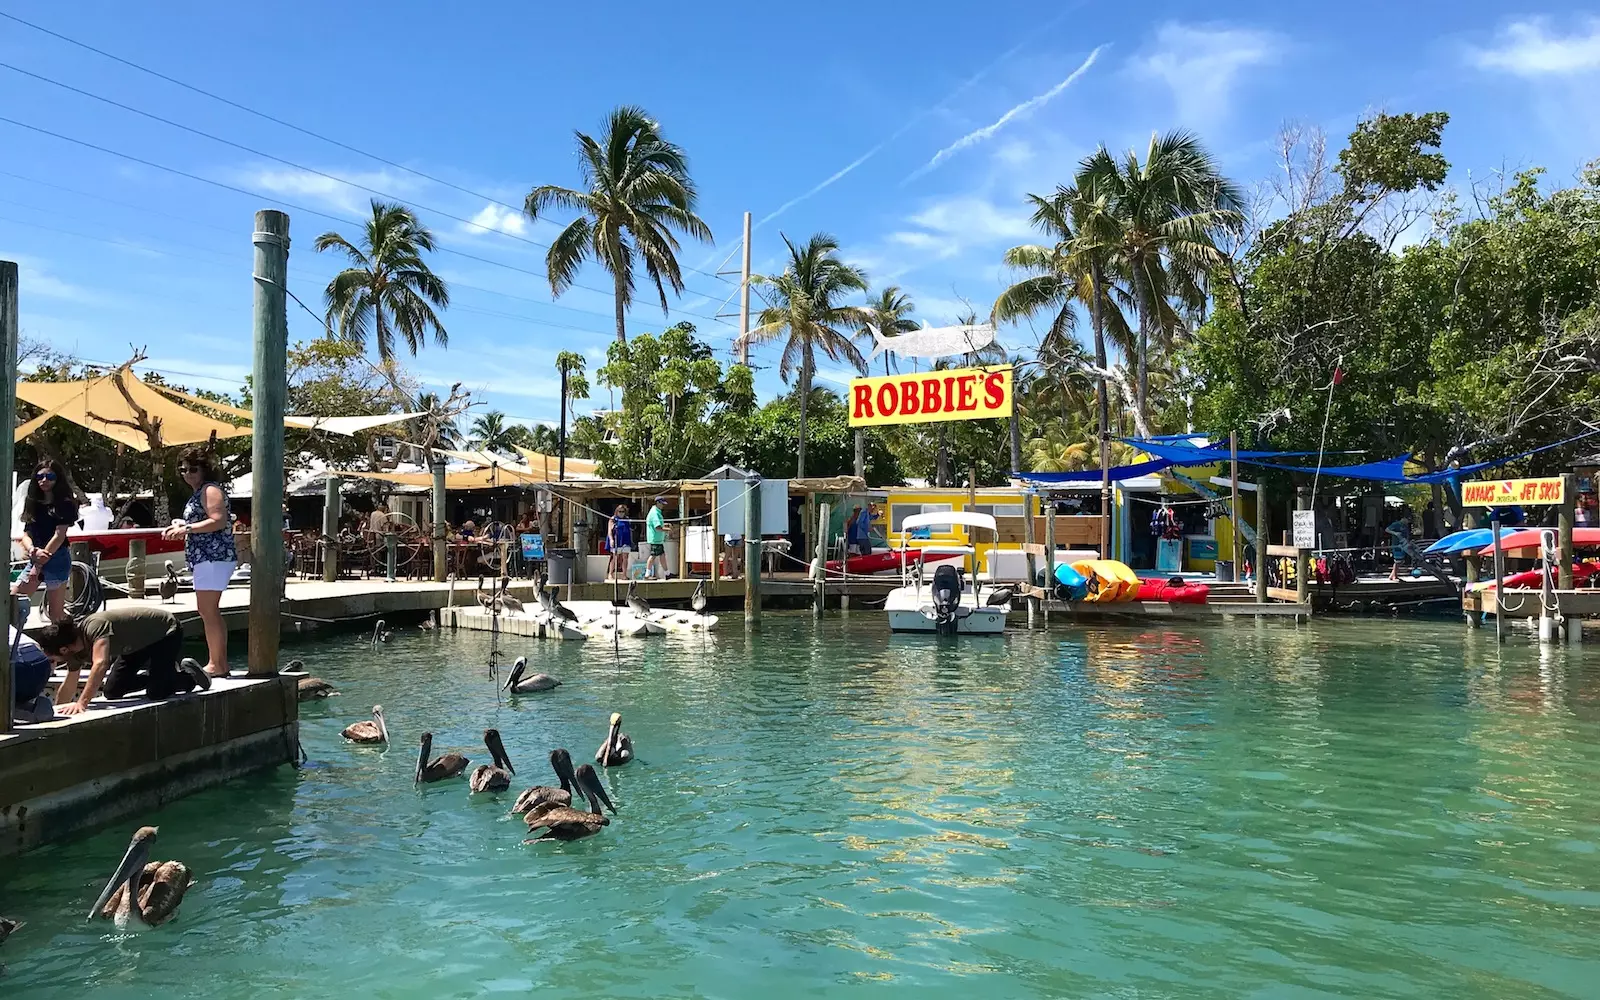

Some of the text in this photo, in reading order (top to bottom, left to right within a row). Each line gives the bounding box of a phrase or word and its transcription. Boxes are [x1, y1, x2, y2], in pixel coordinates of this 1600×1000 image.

[853, 372, 1005, 419] ROBBIE'S
[1464, 481, 1561, 504] KAYAKS JET SKIS
